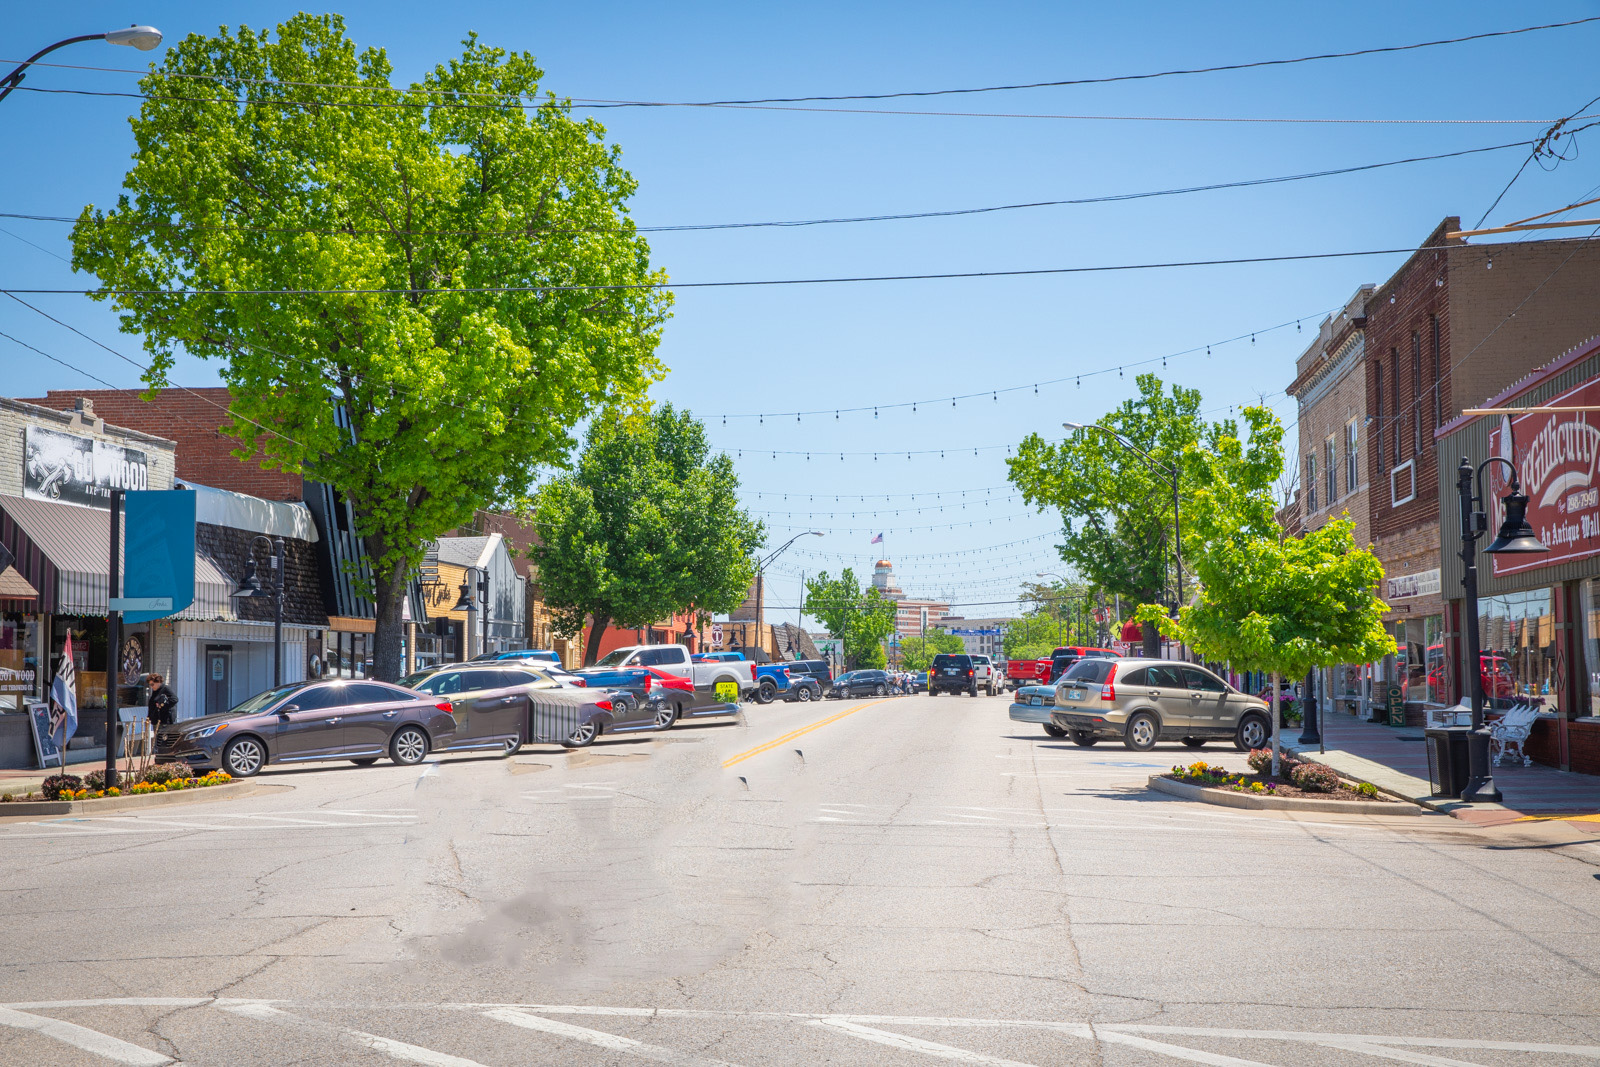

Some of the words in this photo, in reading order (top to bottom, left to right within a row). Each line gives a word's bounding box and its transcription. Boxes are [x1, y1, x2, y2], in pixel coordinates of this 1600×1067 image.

[110, 460, 147, 491] WOOD
[1552, 520, 1580, 548] Antique
[15, 670, 35, 681] WOOD
[1390, 688, 1403, 724] OPEN
